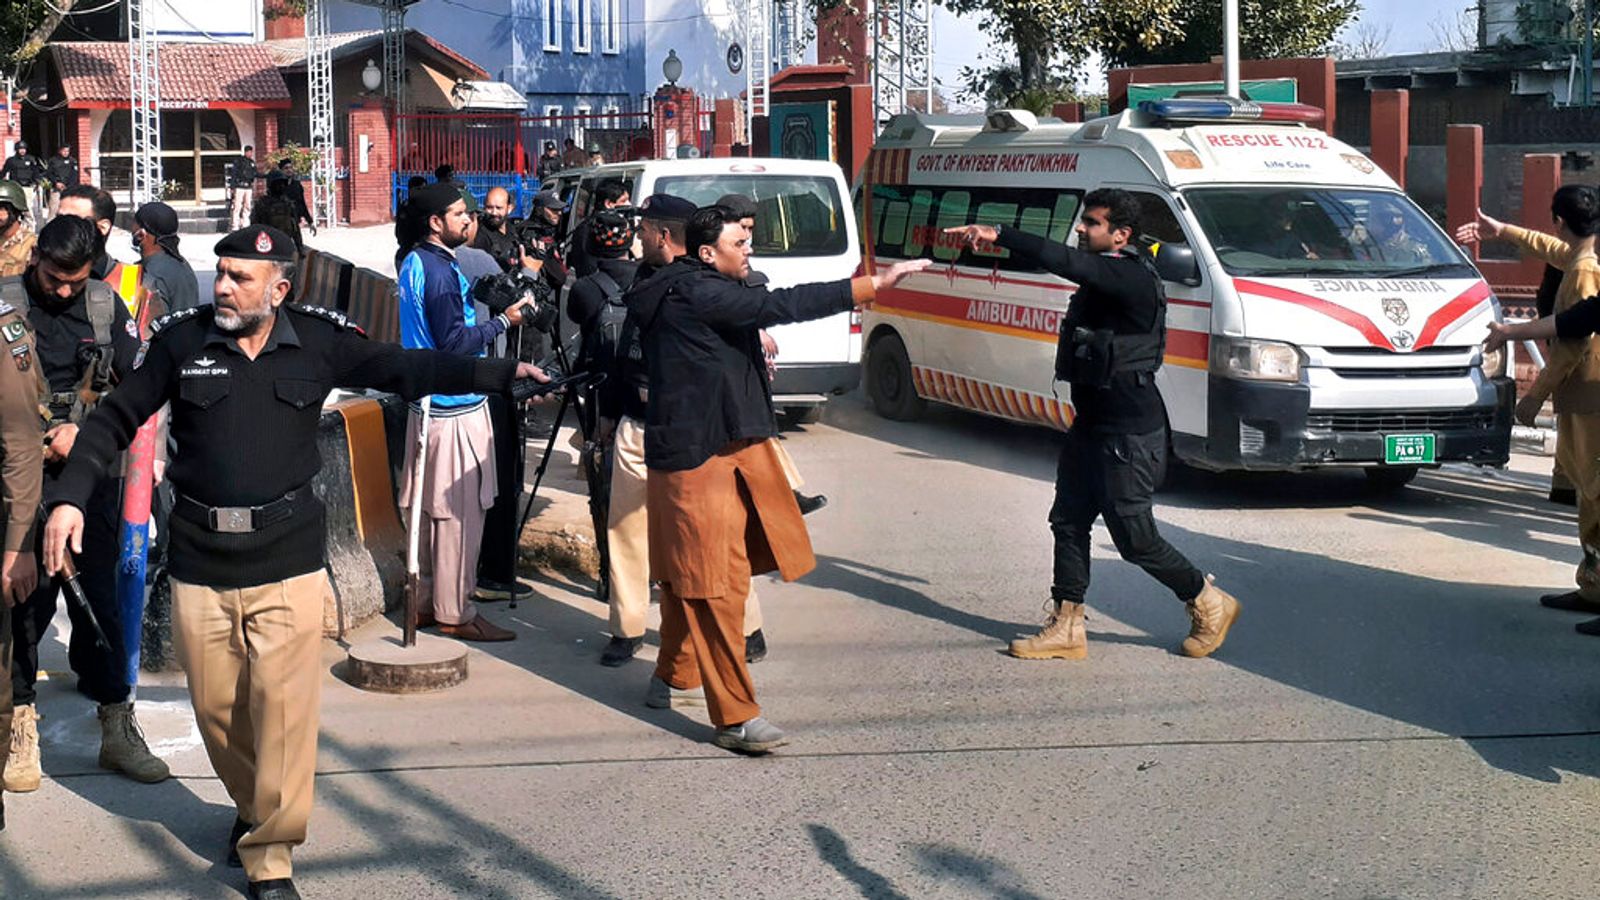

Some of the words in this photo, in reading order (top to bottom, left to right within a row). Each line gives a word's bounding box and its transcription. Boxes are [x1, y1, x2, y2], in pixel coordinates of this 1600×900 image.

[1206, 134, 1283, 147] RESCUE
[1286, 135, 1329, 149] 1122
[916, 154, 943, 171] GOVT.
[944, 154, 958, 171] OF
[957, 154, 998, 172] KHYBER
[998, 152, 1079, 172] PAKHTUNKHWA
[1286, 161, 1312, 169] Care
